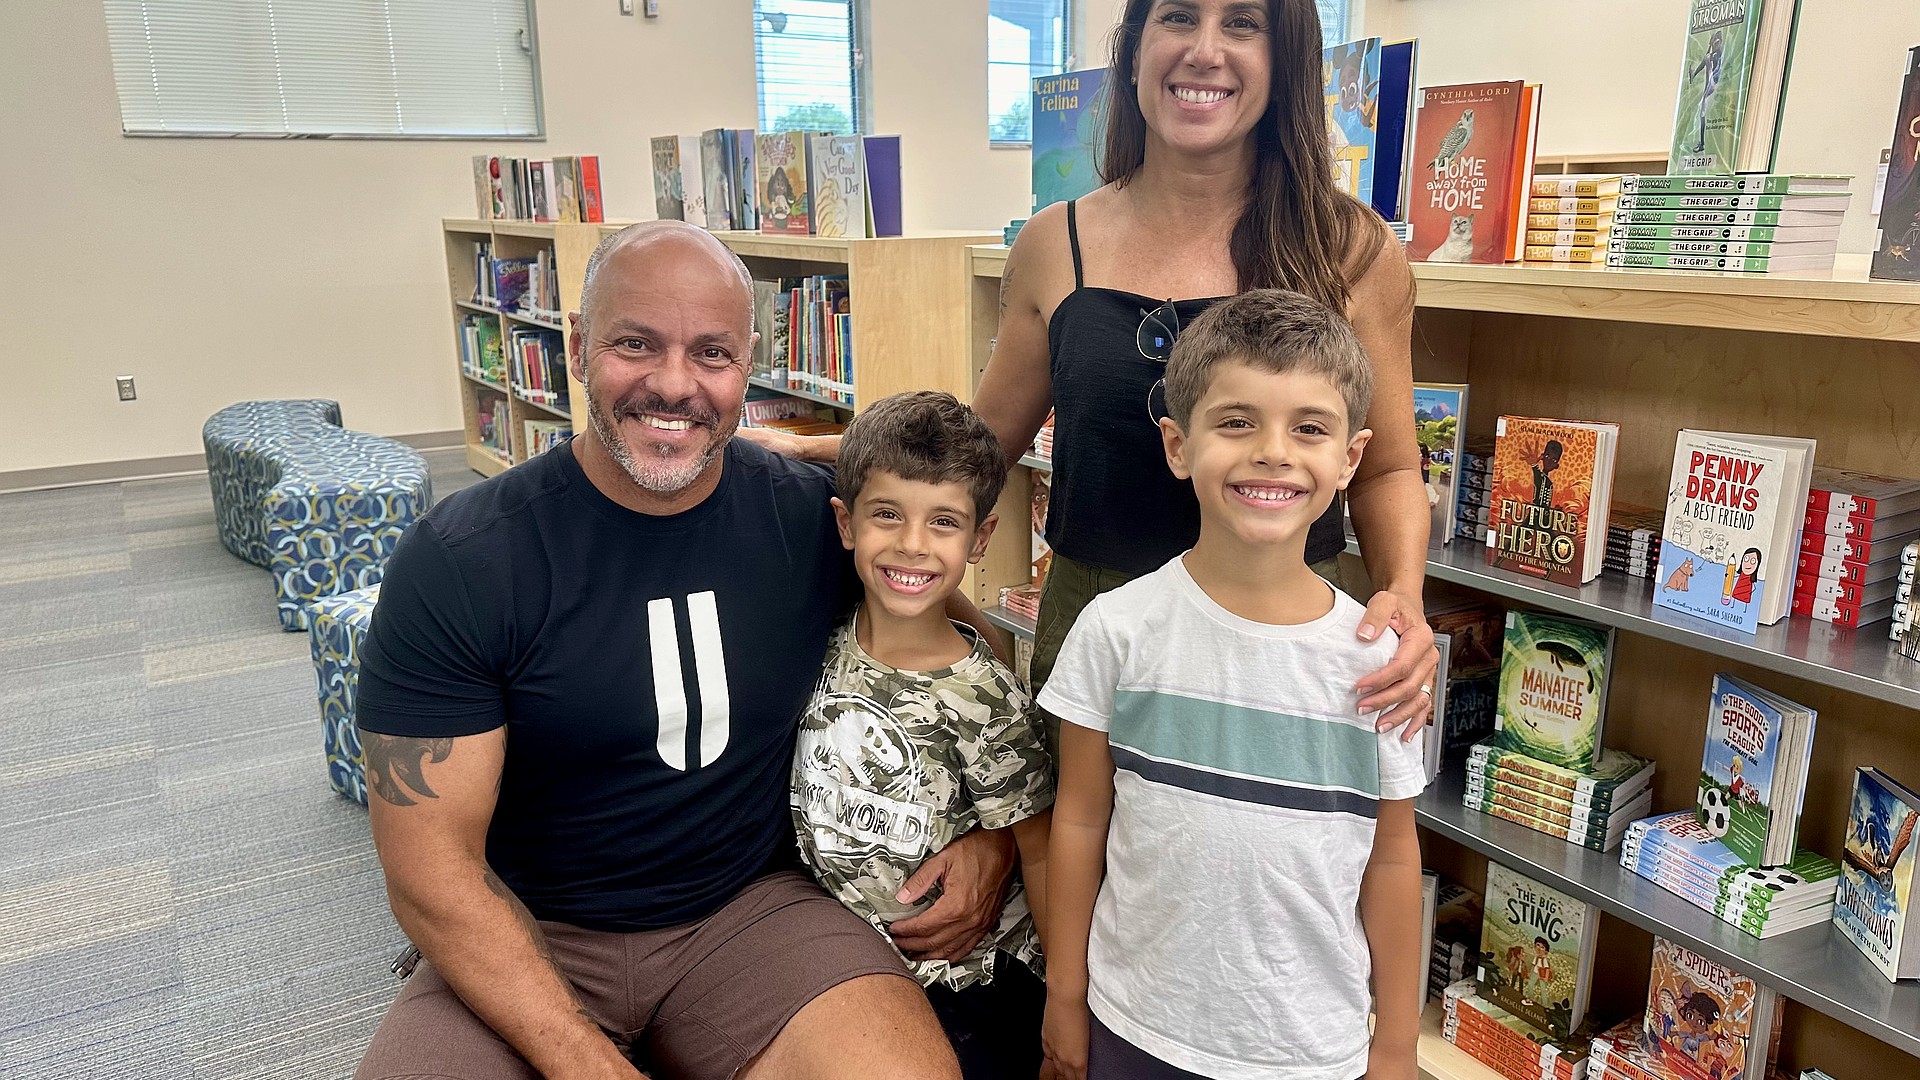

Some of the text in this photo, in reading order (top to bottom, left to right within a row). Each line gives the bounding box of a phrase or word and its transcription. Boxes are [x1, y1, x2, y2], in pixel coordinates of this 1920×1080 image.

[1692, 0, 1746, 28] STROMAN
[1036, 77, 1079, 95] Carina
[1426, 87, 1510, 100] CYNTHIA LORD
[1041, 94, 1079, 112] Felina
[1684, 157, 1712, 168] THE GRIP
[1426, 176, 1488, 191] away from
[1708, 180, 1729, 188] GRIP
[1430, 188, 1485, 212] HOME
[1686, 198, 1700, 206] THE
[1702, 198, 1722, 206] GRIP
[1689, 258, 1709, 266] GRIP
[752, 400, 813, 420] UNICORNS
[1689, 450, 1765, 486] PENNY
[1685, 475, 1760, 512] DRAWS
[1500, 499, 1579, 536] FUTURE
[1683, 500, 1754, 531] A BEST FRIEND
[1497, 522, 1576, 564] HERO
[1498, 550, 1514, 560] RACE
[1515, 554, 1524, 562] TO
[1524, 556, 1537, 566] FIRE
[1538, 559, 1572, 574] MOUNTAIN
[1706, 606, 1720, 619] SARA
[1720, 610, 1743, 625] SHEPARD
[1521, 666, 1584, 706] MANATEE
[1519, 692, 1582, 721] SUMMER
[1728, 695, 1764, 727] THE GOOD
[1722, 709, 1765, 752] SPORTS
[1727, 728, 1756, 756] LEAGUE
[835, 790, 921, 843] WORLD
[1669, 821, 1703, 838] SPO
[1664, 853, 1672, 861] THE
[1660, 880, 1669, 888] THE
[1516, 887, 1557, 914] THE BIG
[1864, 888, 1876, 910] THE
[1507, 897, 1563, 943] STING
[1841, 876, 1896, 951] SHELTERLINGS
[1839, 912, 1890, 967] SARAH BETH DURST
[1676, 947, 1728, 989] A SPIDER
[1486, 1028, 1525, 1055] THE BIG STING
[1488, 1019, 1526, 1045] THE BIG STING
[1485, 1058, 1495, 1067] THE
[1495, 1063, 1505, 1074] BIG
[1486, 1048, 1524, 1075] THE BIG STING
[1489, 1040, 1527, 1067] THE BIG STING
[1606, 1053, 1639, 1079] THE GIRL
